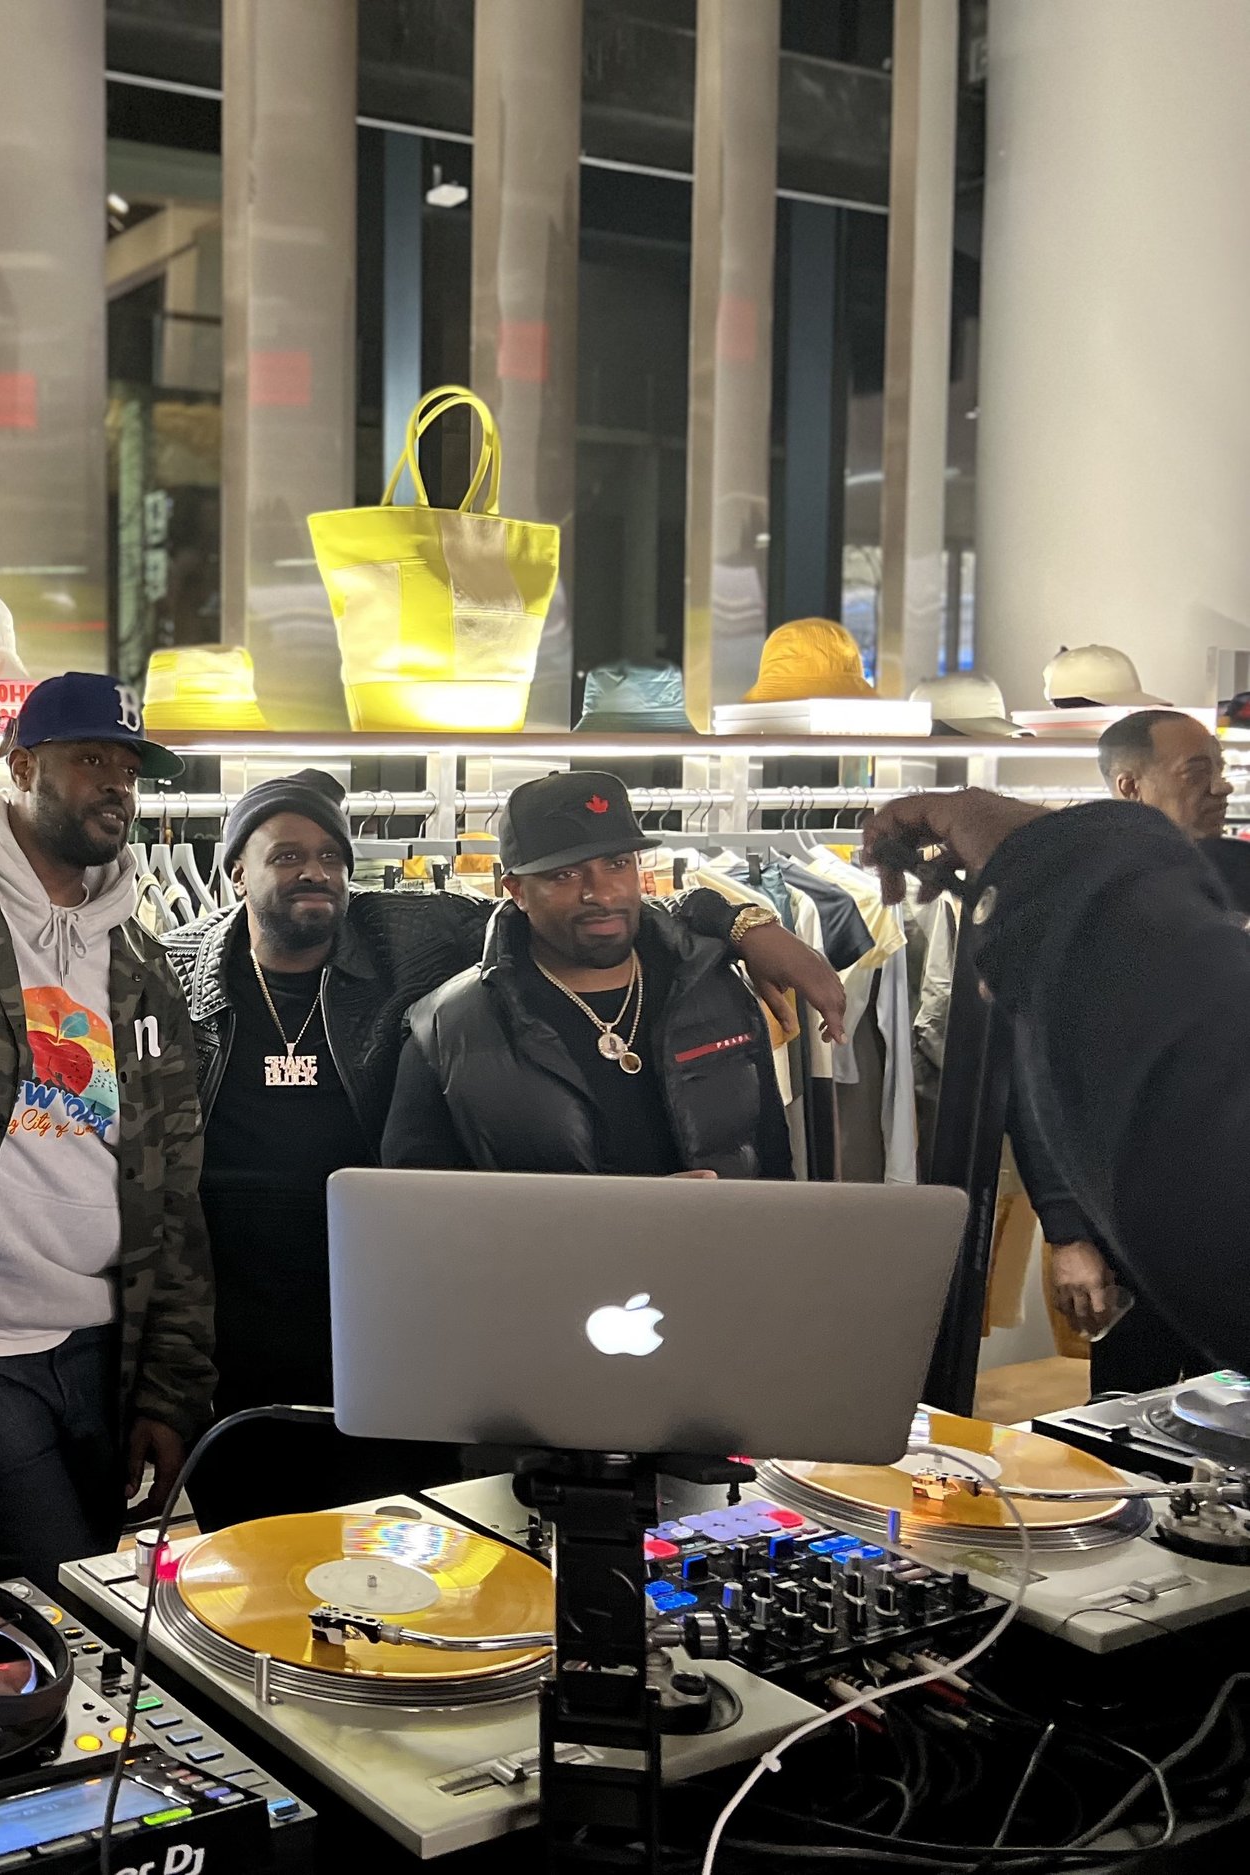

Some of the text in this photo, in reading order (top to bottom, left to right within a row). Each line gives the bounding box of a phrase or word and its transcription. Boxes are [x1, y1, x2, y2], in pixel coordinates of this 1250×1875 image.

[114, 685, 141, 732] B
[134, 1015, 161, 1061] n
[21, 1108, 52, 1137] City
[55, 1121, 71, 1138] of
